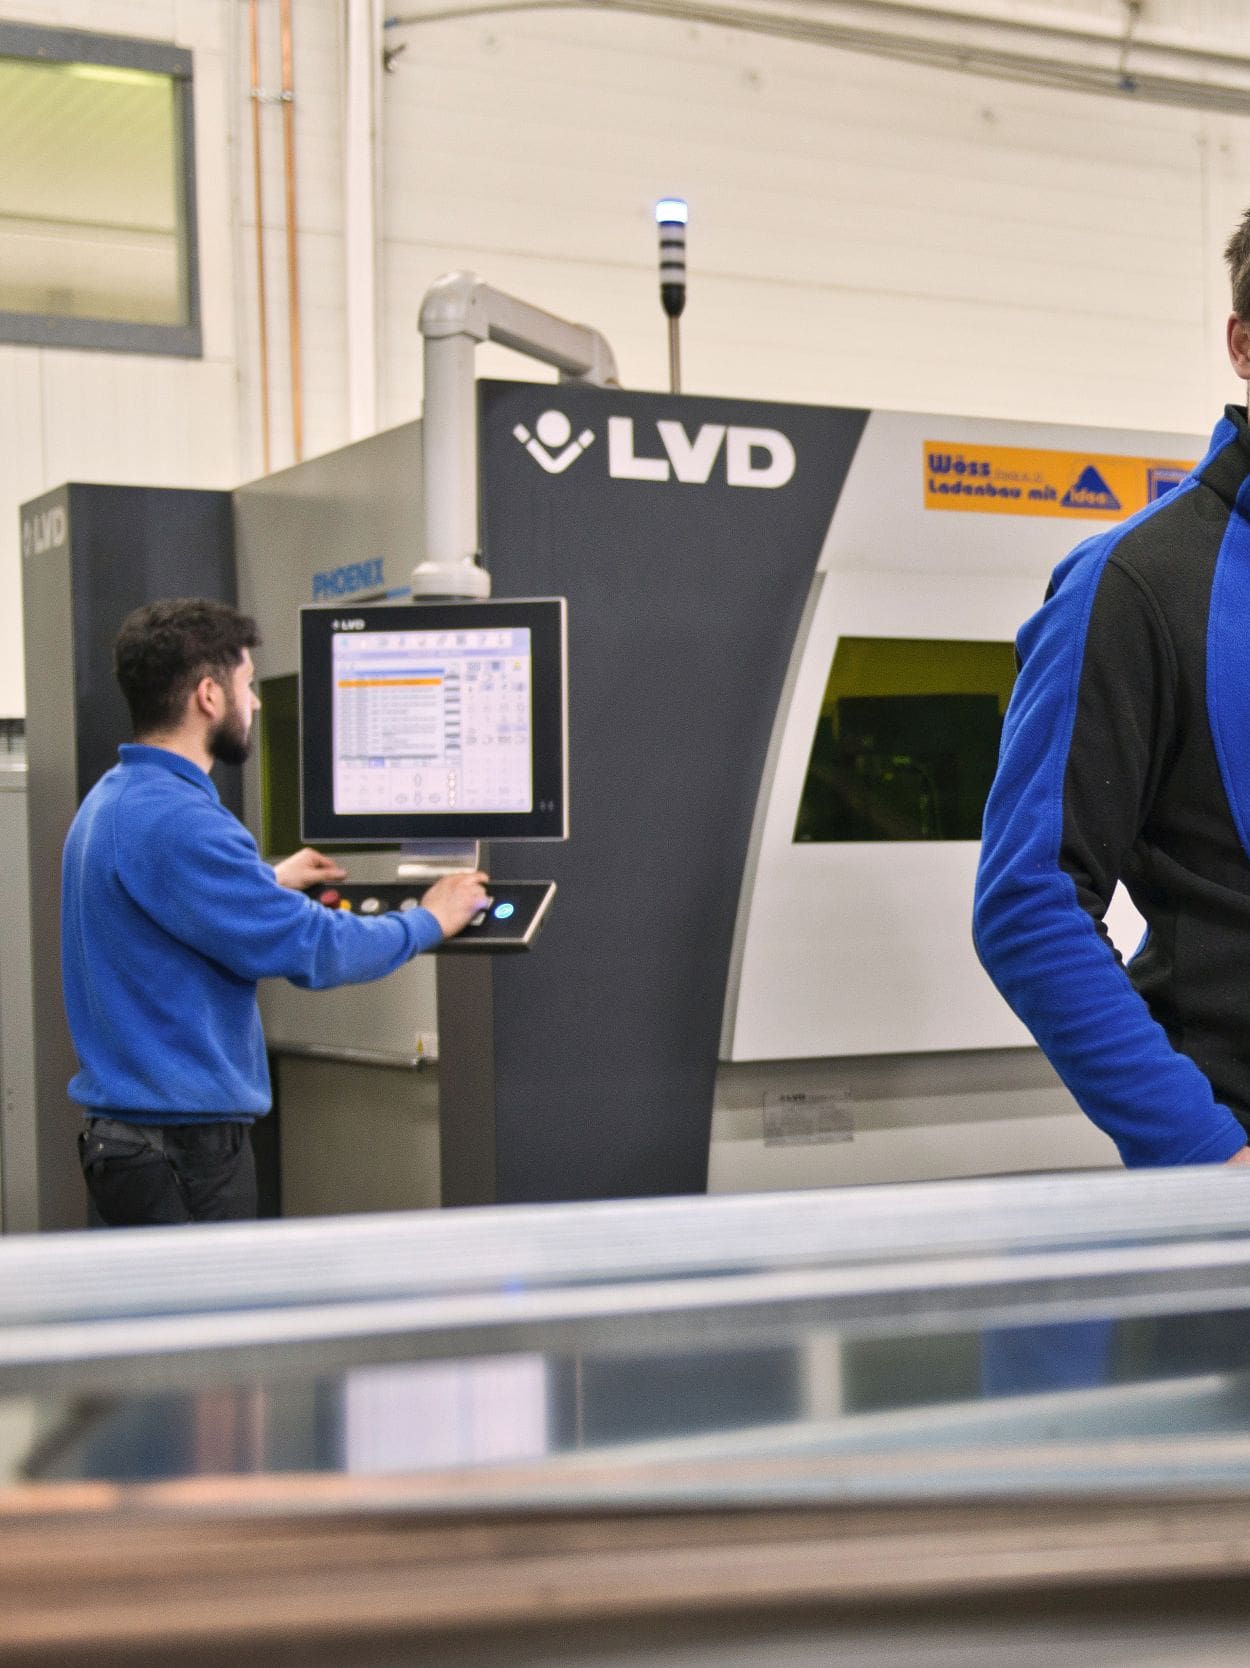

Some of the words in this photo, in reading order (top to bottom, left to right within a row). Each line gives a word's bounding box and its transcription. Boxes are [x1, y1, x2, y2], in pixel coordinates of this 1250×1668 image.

[608, 416, 796, 489] LVD
[928, 455, 990, 476] Wöss
[928, 479, 1021, 498] Ladenbau
[1028, 486, 1057, 500] mit
